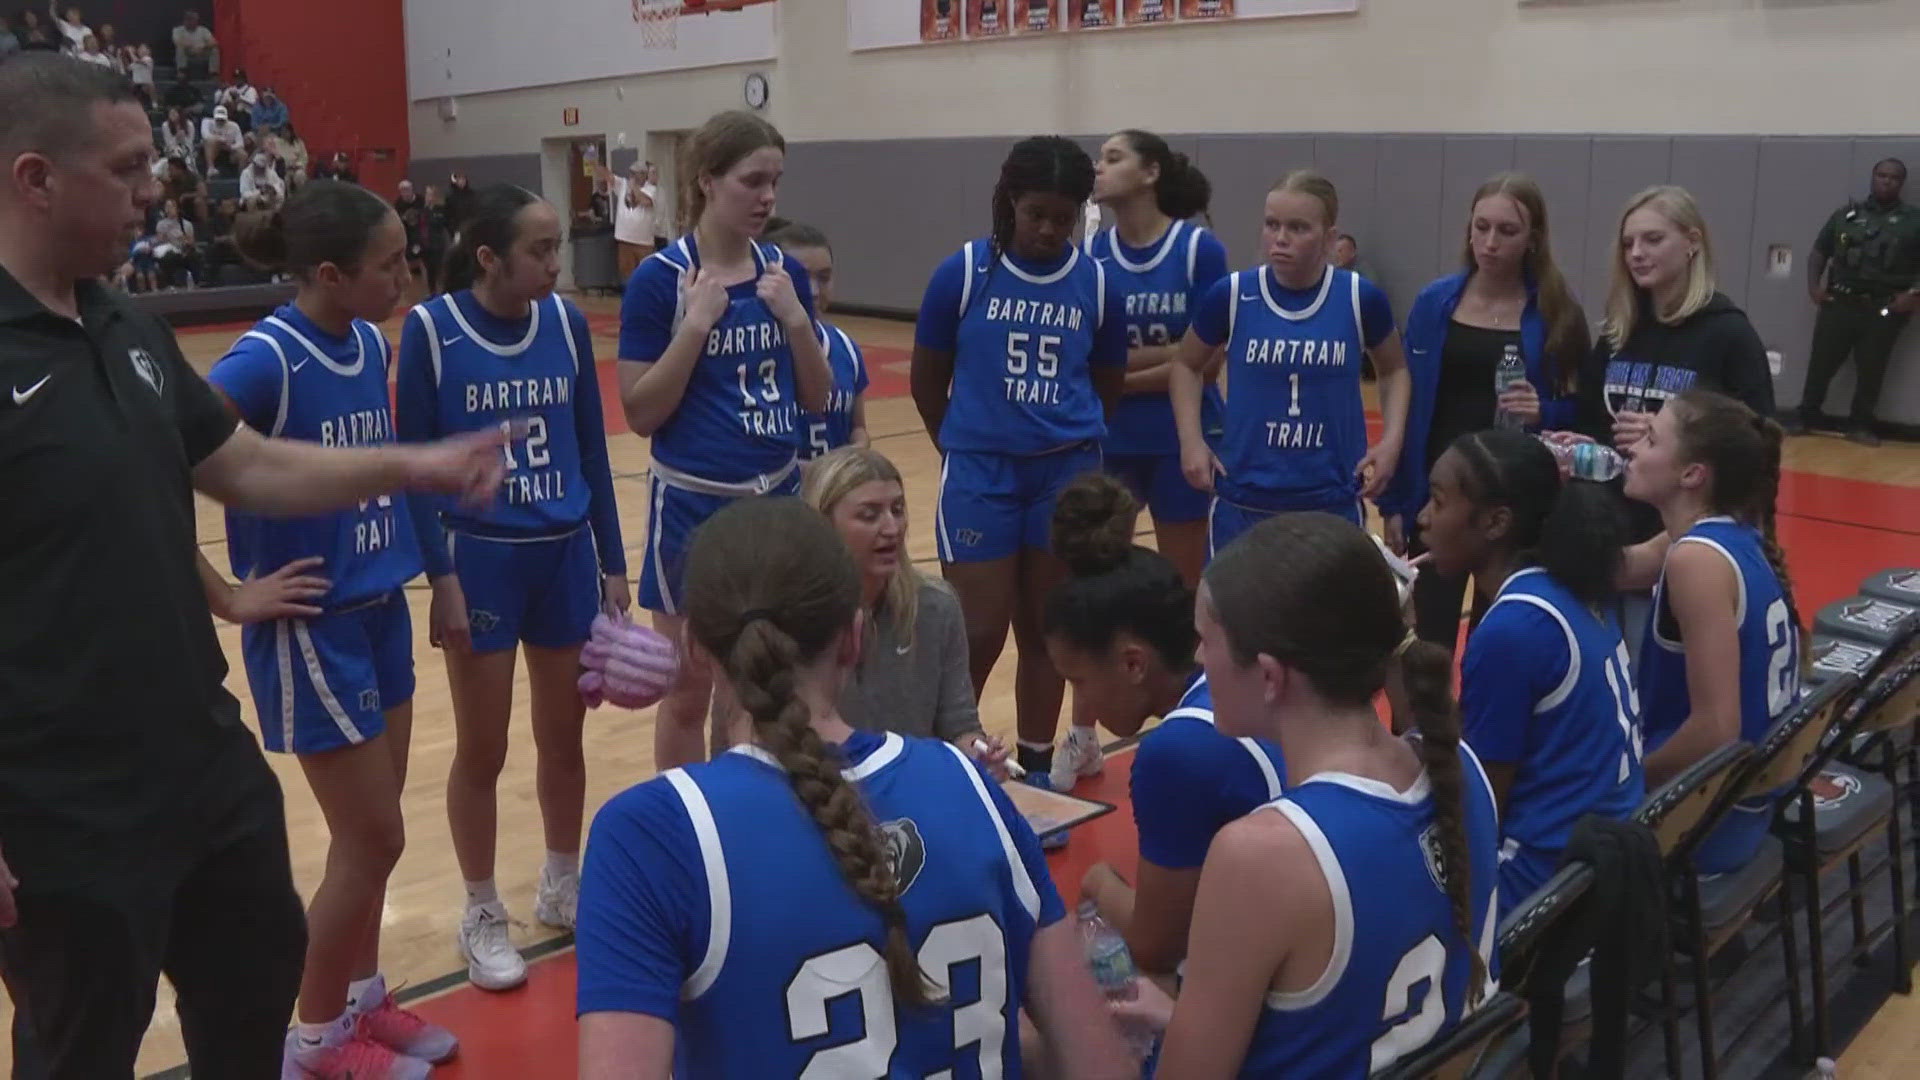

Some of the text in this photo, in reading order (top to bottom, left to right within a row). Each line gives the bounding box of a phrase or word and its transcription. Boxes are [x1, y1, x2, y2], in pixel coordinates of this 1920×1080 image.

[986, 297, 1082, 332] BARTRAM
[1126, 292, 1187, 315] RTRAM
[1007, 331, 1061, 379] 55
[1245, 339, 1346, 367] BARTRAM
[466, 376, 569, 413] BARTRAM
[737, 359, 780, 407] 13
[1004, 377, 1060, 405] TRAIL
[1288, 373, 1300, 417] 1
[321, 408, 390, 449] BARTRA
[738, 407, 793, 435] TRAIL
[1265, 421, 1324, 449] TRAIL
[499, 415, 550, 470] 12
[503, 470, 565, 504] TRAIL
[786, 912, 1008, 1080] 23
